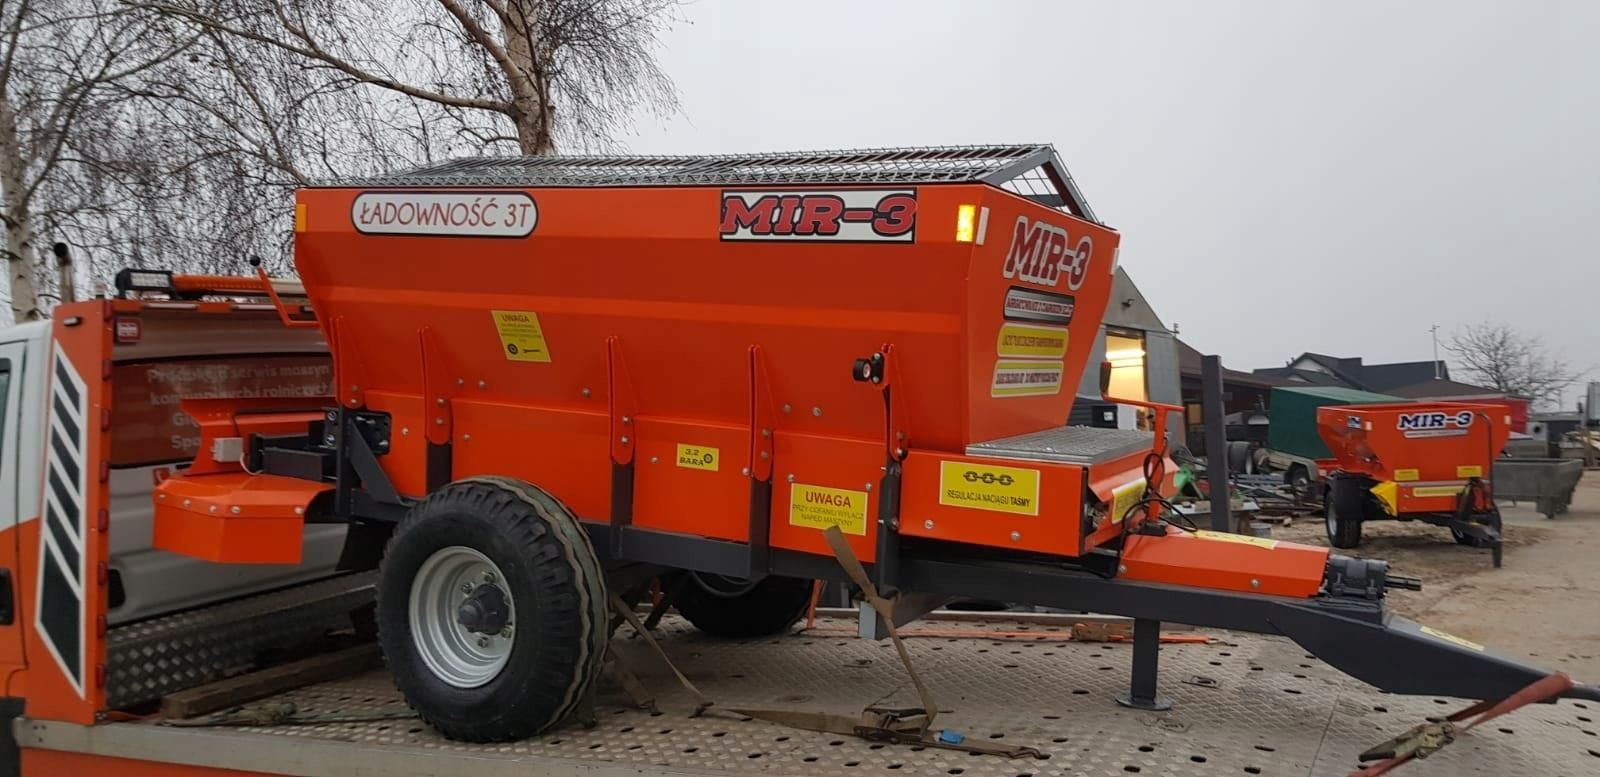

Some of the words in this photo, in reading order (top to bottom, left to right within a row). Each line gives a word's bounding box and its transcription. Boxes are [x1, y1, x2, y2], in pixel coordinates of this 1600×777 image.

[360, 197, 498, 227] ŁADOWNOŚĆ
[503, 203, 531, 229] 3T
[720, 194, 918, 237] MIR-3
[1004, 216, 1092, 290] MIR-3
[1398, 411, 1473, 430] MIR-3
[680, 457, 704, 466] BARA
[806, 491, 851, 508] UWAGA
[947, 489, 981, 501] REGULACJA
